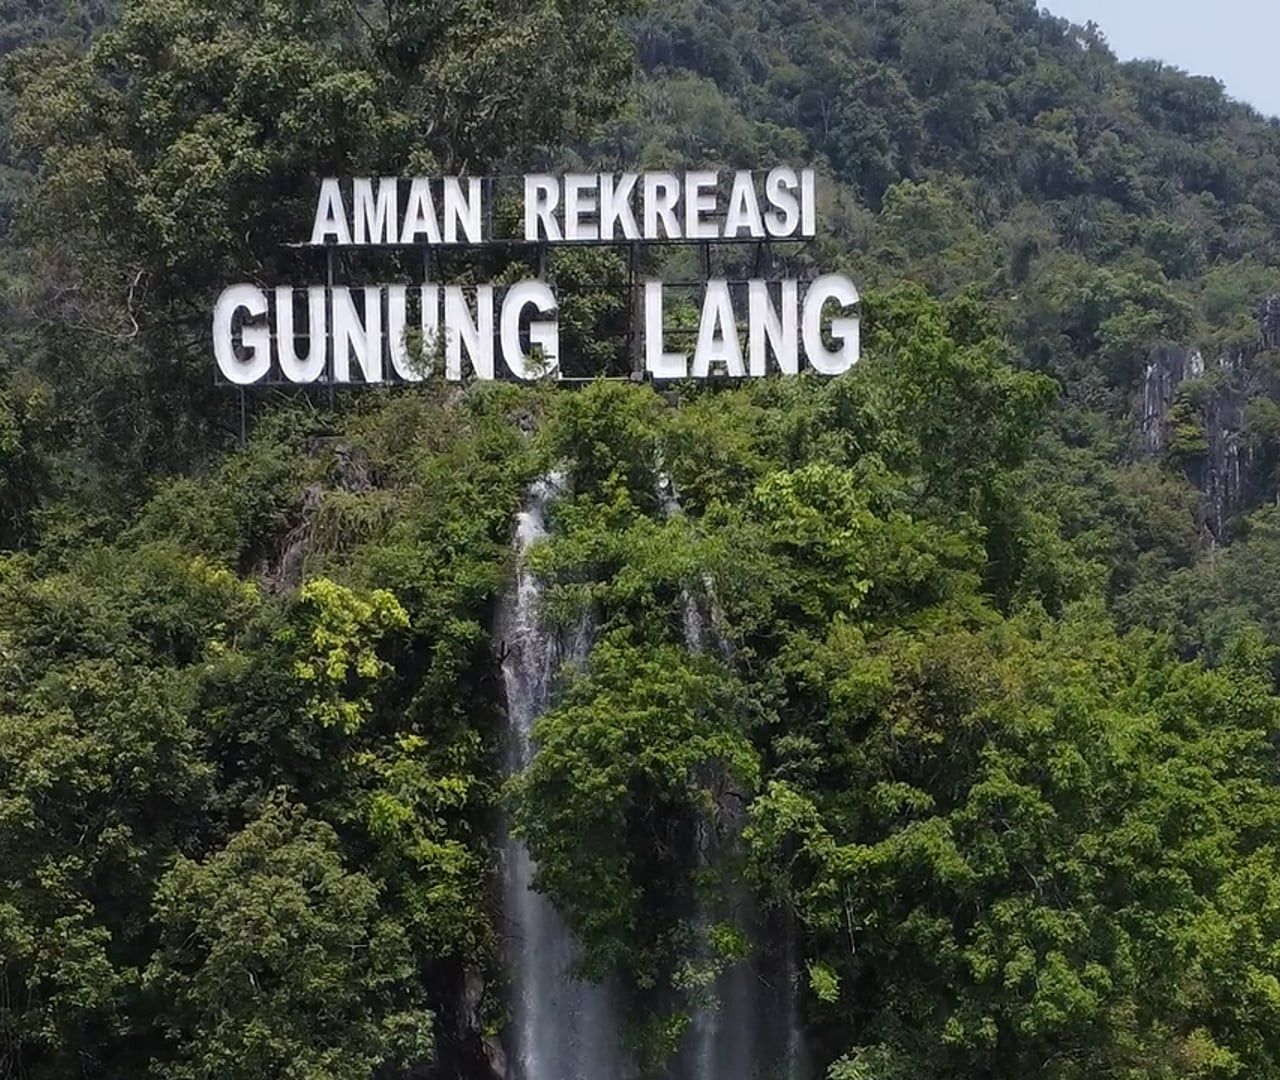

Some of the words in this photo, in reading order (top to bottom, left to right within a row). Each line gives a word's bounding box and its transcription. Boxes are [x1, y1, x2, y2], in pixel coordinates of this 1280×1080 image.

[311, 177, 483, 244] AMAN
[523, 166, 817, 241] REKREASI
[212, 280, 560, 385] GUNUNG
[645, 274, 861, 378] LANG
